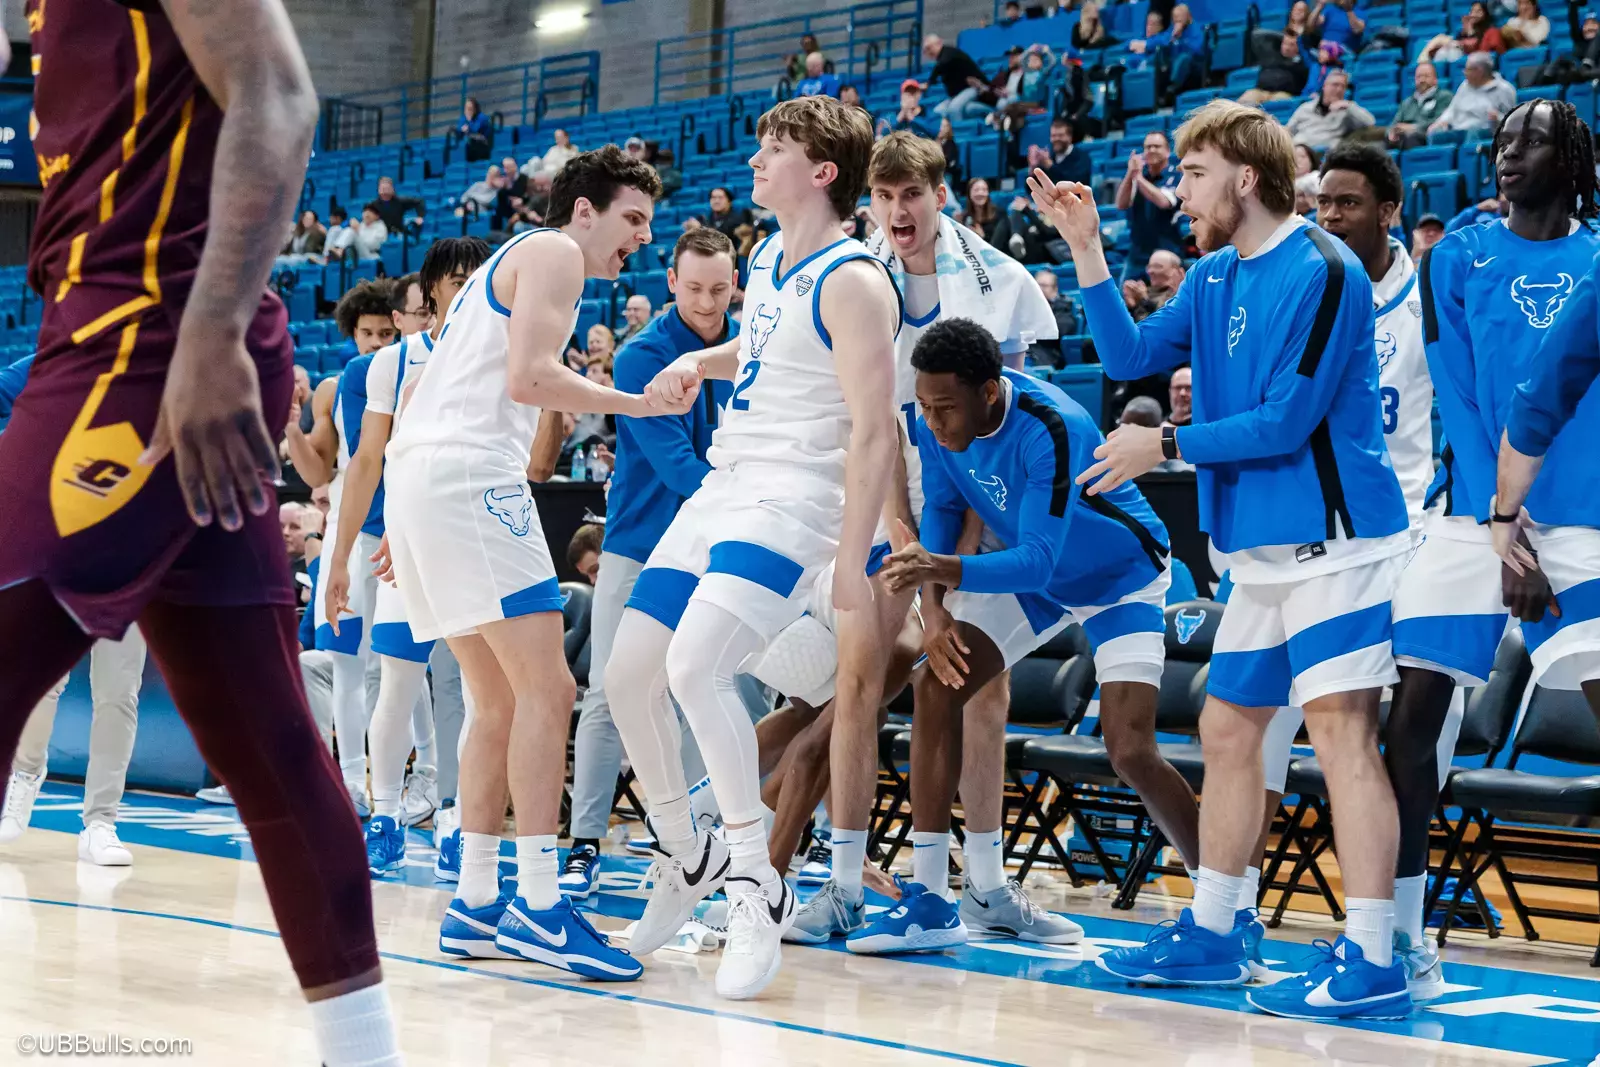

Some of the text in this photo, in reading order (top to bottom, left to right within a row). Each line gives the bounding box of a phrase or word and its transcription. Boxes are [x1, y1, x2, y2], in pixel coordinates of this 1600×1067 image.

[0, 127, 16, 144] p
[732, 360, 762, 411] 2
[1379, 386, 1400, 435] 3
